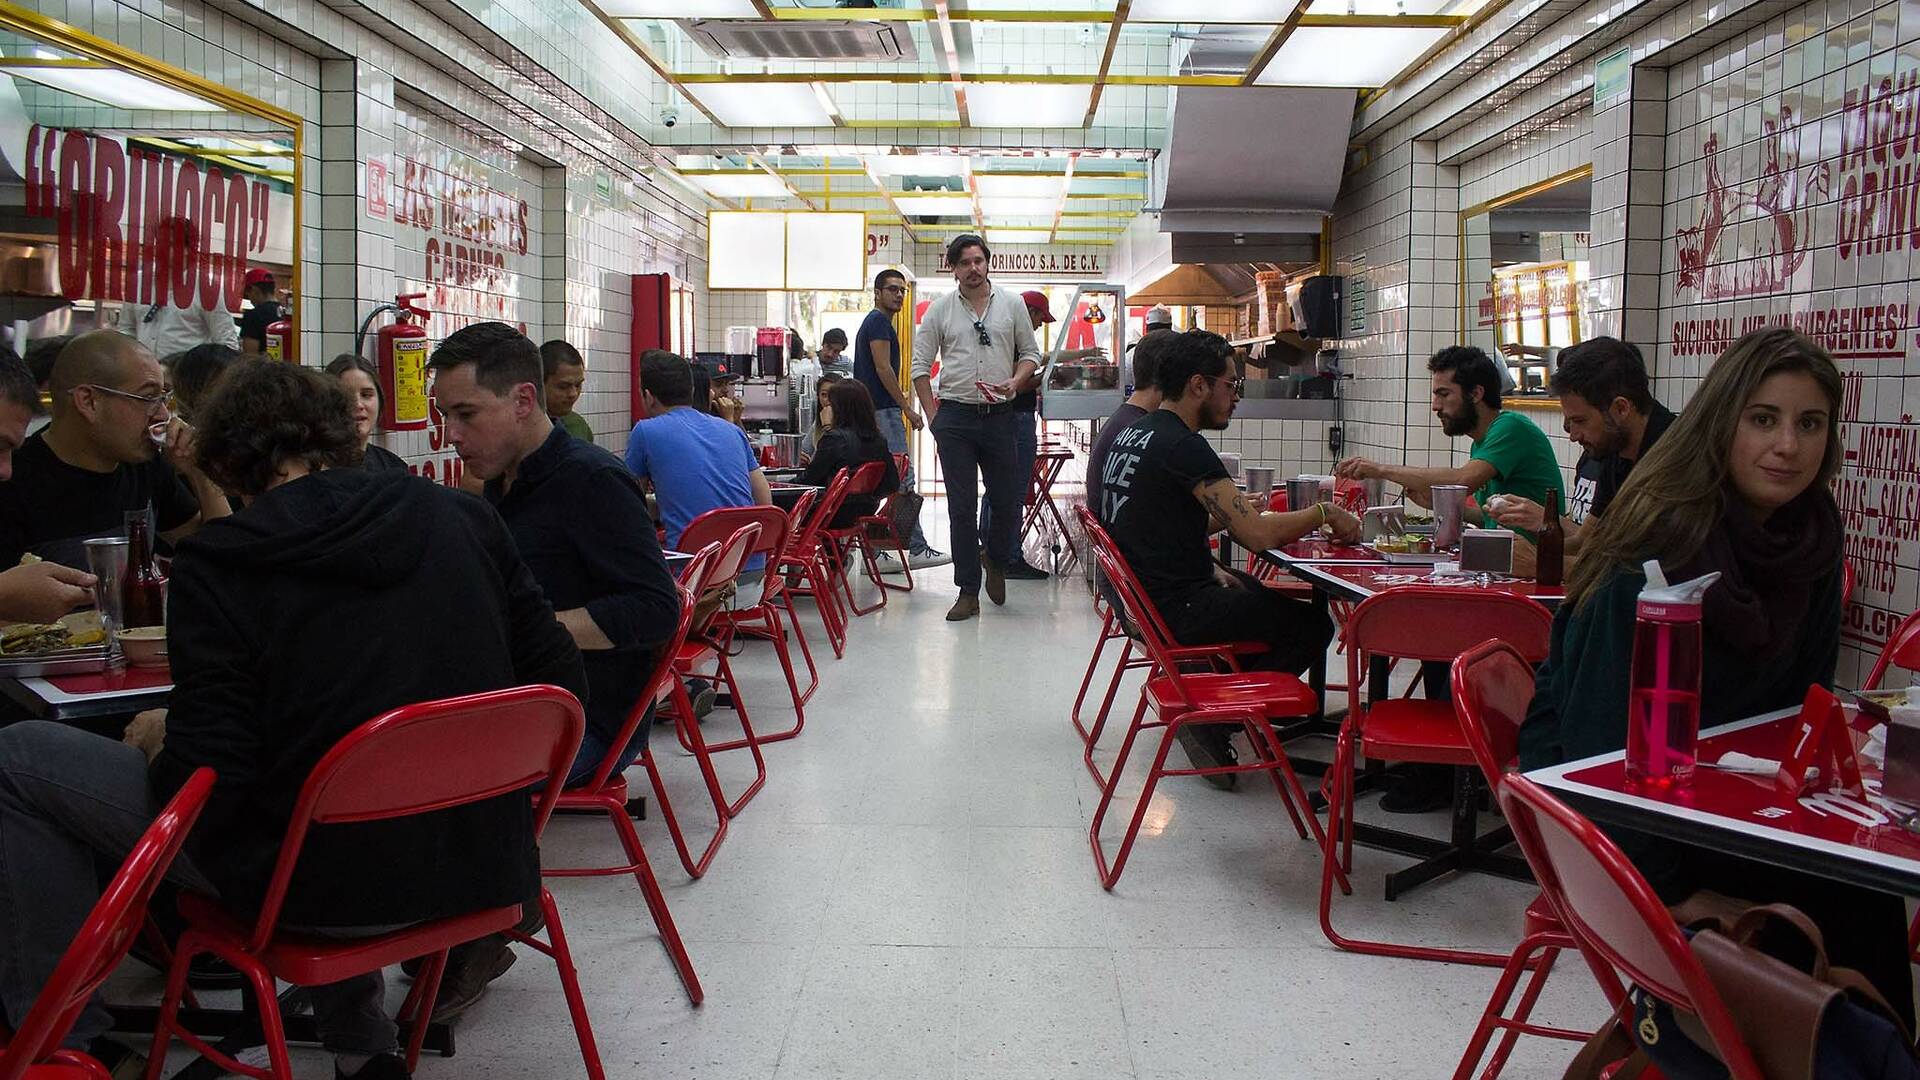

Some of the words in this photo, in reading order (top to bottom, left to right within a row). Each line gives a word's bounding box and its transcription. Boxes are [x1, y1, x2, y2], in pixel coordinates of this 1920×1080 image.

[991, 254, 1036, 270] ORINOCO
[1040, 254, 1059, 270] S.A.
[1063, 254, 1076, 270] DE
[1080, 254, 1099, 270] C.V.
[1113, 427, 1143, 446] AVE
[1134, 430, 1154, 449] A
[1103, 451, 1141, 488] ICE
